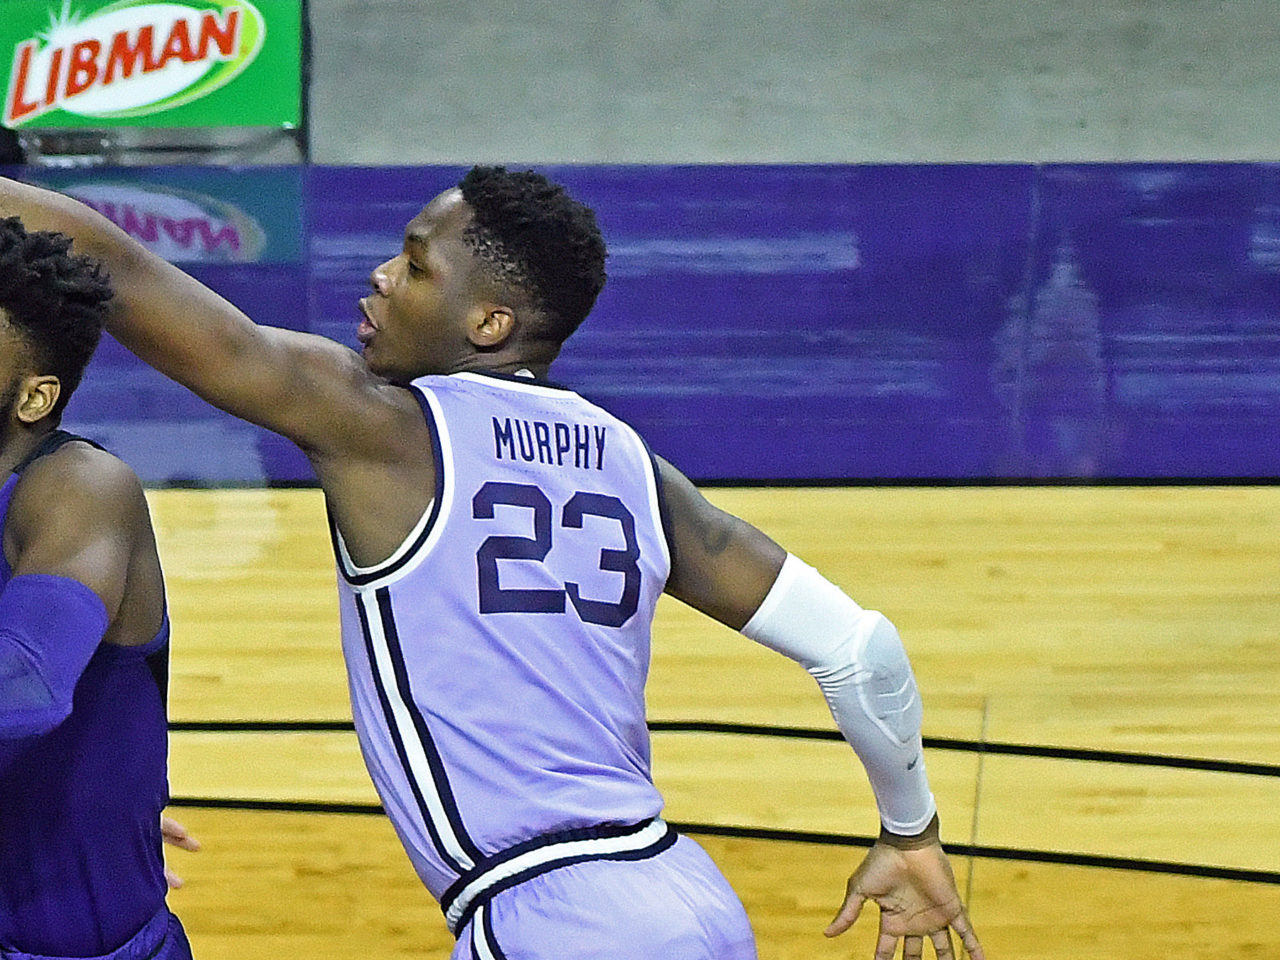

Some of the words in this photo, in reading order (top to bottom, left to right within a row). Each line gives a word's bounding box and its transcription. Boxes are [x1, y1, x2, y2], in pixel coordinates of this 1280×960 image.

[10, 9, 239, 121] LIBMAN
[492, 416, 606, 471] MURPHY
[472, 481, 642, 628] 23
